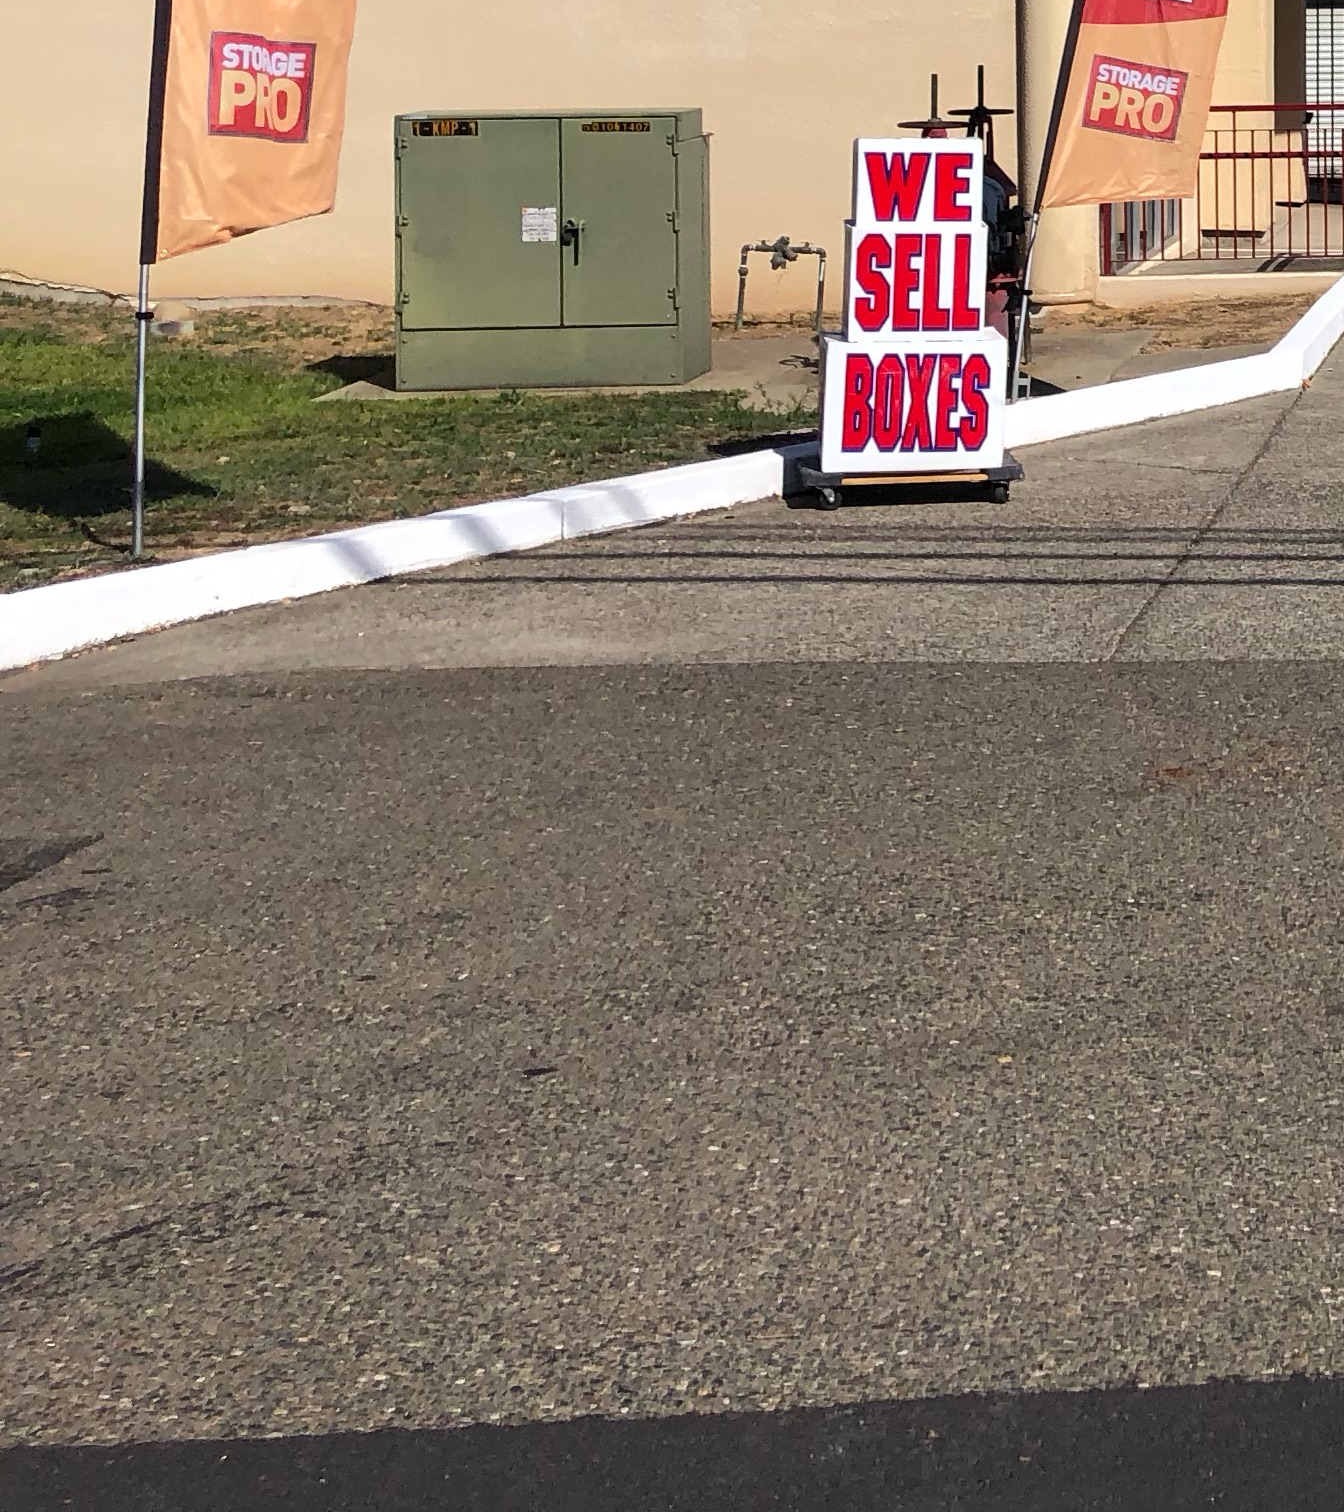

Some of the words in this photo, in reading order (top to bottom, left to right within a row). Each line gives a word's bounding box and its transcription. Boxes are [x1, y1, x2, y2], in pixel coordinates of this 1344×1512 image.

[222, 43, 307, 78] STORAGE
[1096, 63, 1181, 96] STORAGE
[218, 69, 302, 133] PRO
[1089, 81, 1175, 133] PRO
[863, 152, 974, 222] WE
[853, 232, 981, 333] SELL
[841, 352, 992, 453] BOXES
